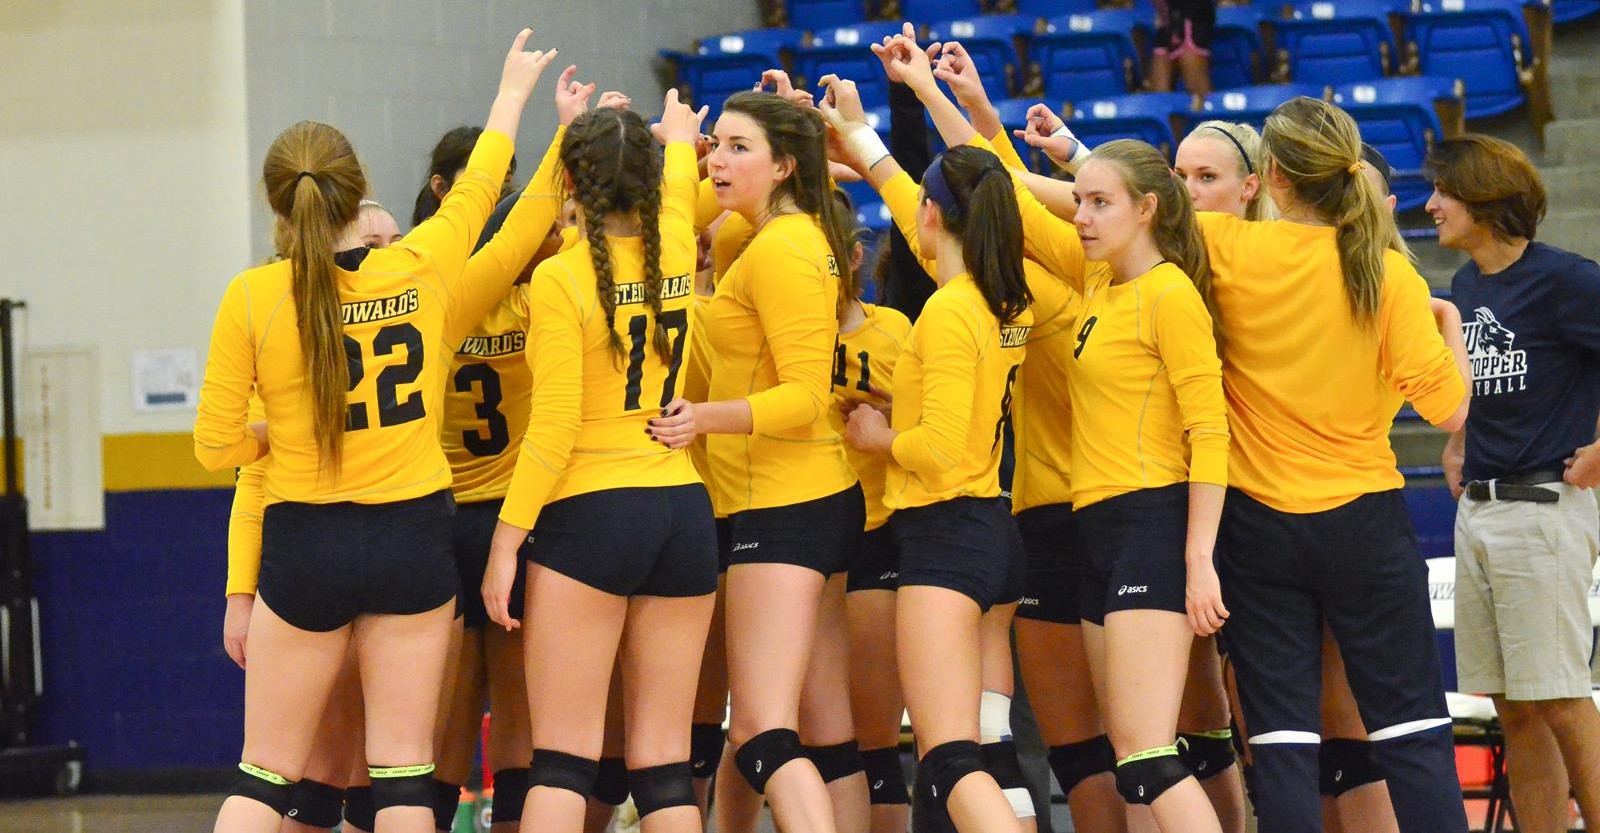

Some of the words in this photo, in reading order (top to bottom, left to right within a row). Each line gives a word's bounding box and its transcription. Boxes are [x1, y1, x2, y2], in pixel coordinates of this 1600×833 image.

[342, 288, 419, 324] DWARD'S
[457, 332, 526, 356] WARD'S
[624, 308, 688, 411] 17
[832, 343, 871, 392] 11
[1471, 352, 1525, 377] OPPER
[1475, 375, 1526, 396] YBALL
[454, 363, 510, 456] 3
